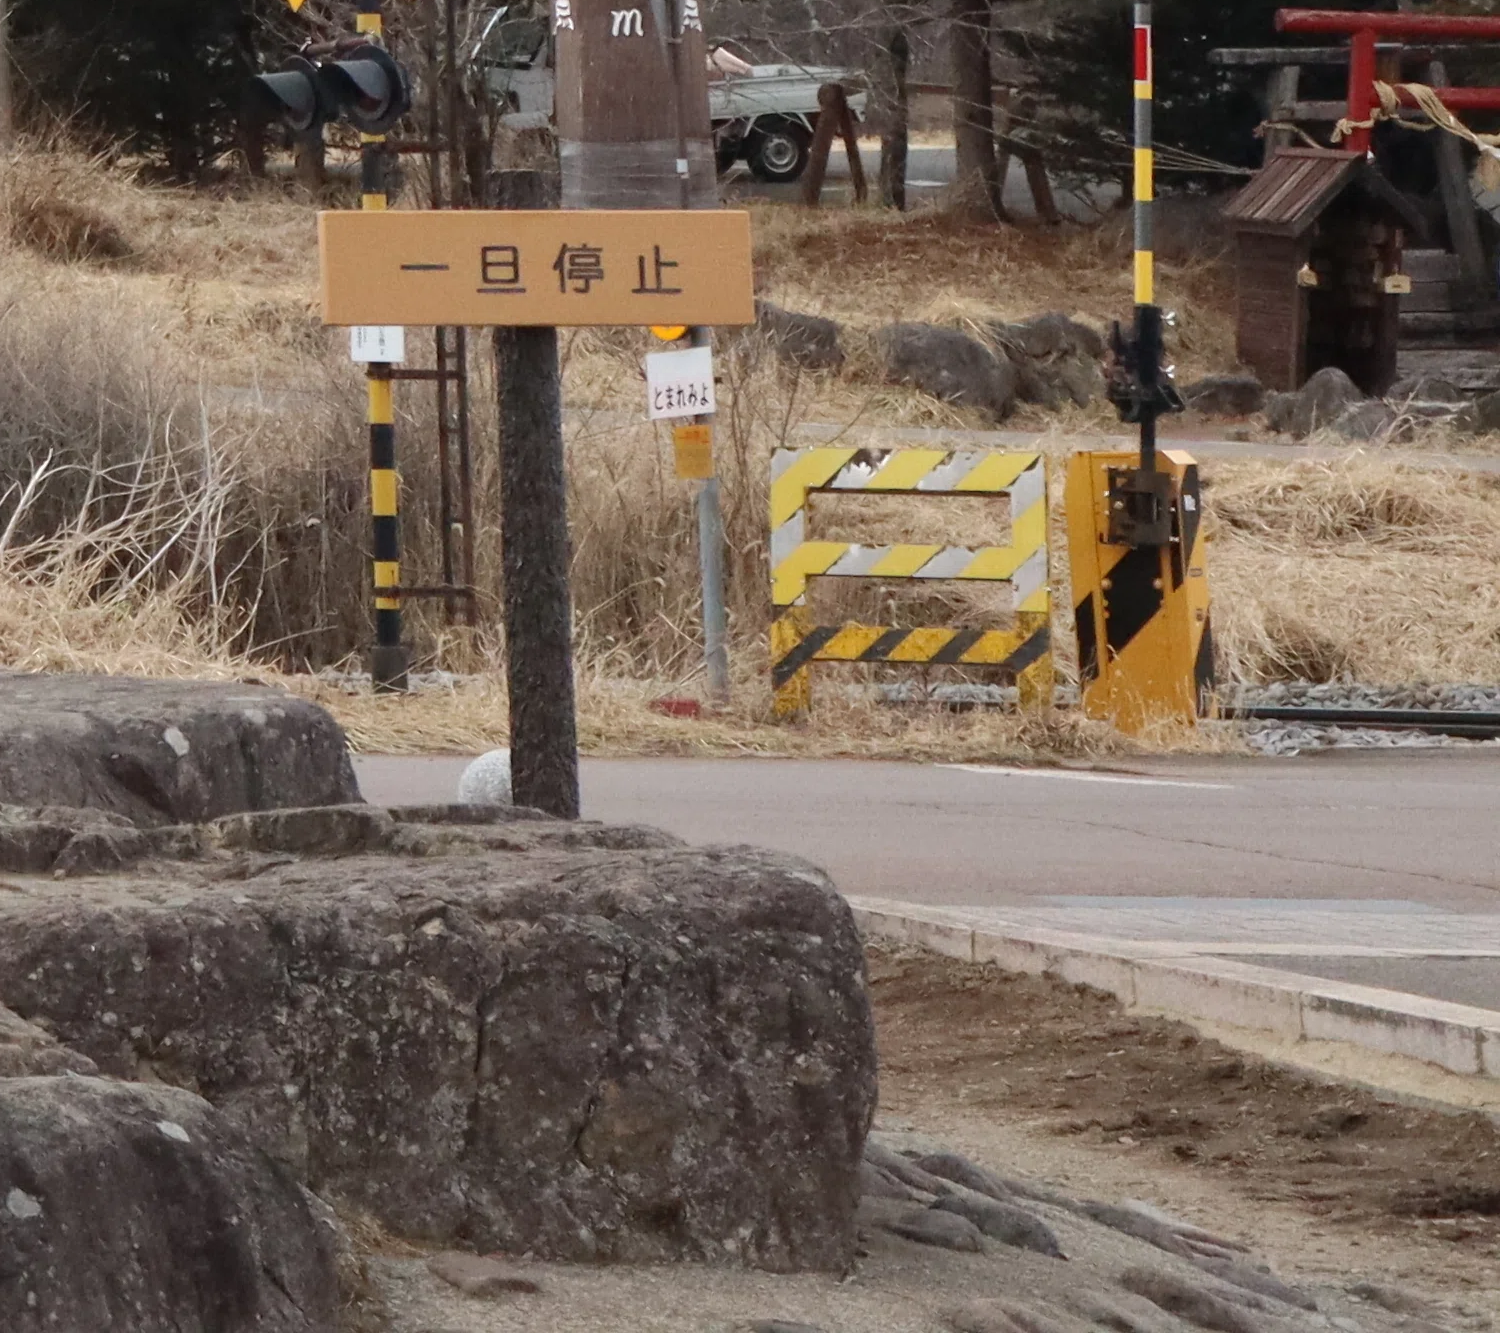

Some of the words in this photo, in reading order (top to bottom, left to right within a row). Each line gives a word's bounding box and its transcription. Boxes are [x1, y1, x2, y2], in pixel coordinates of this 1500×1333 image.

[400, 243, 682, 294] 一旦停止
[654, 383, 710, 411] とまれみよ
